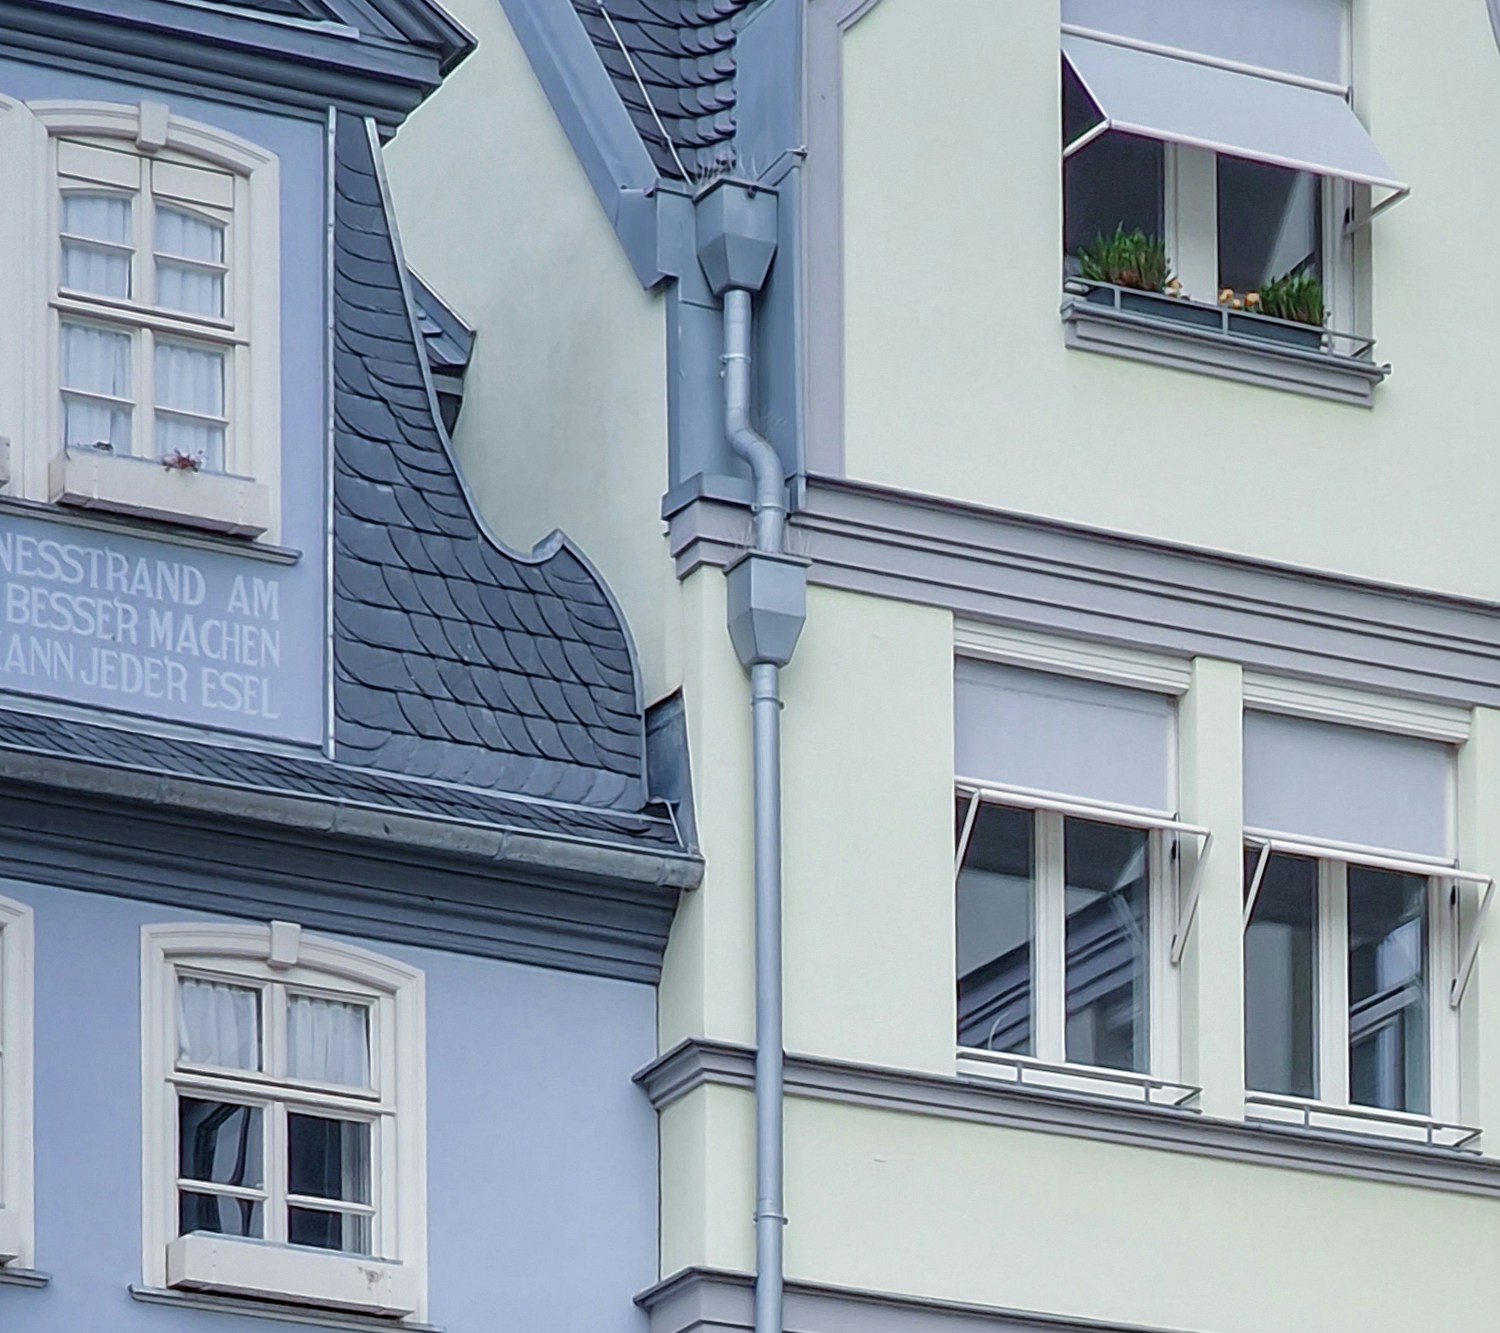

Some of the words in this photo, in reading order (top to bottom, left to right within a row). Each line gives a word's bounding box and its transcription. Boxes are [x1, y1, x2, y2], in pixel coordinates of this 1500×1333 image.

[6, 582, 138, 645] BESSER
[150, 607, 280, 669] MACHEN
[227, 574, 280, 621] AM
[0, 631, 74, 682] ANN
[80, 646, 188, 703] JEDER
[201, 668, 280, 719] ESEL
